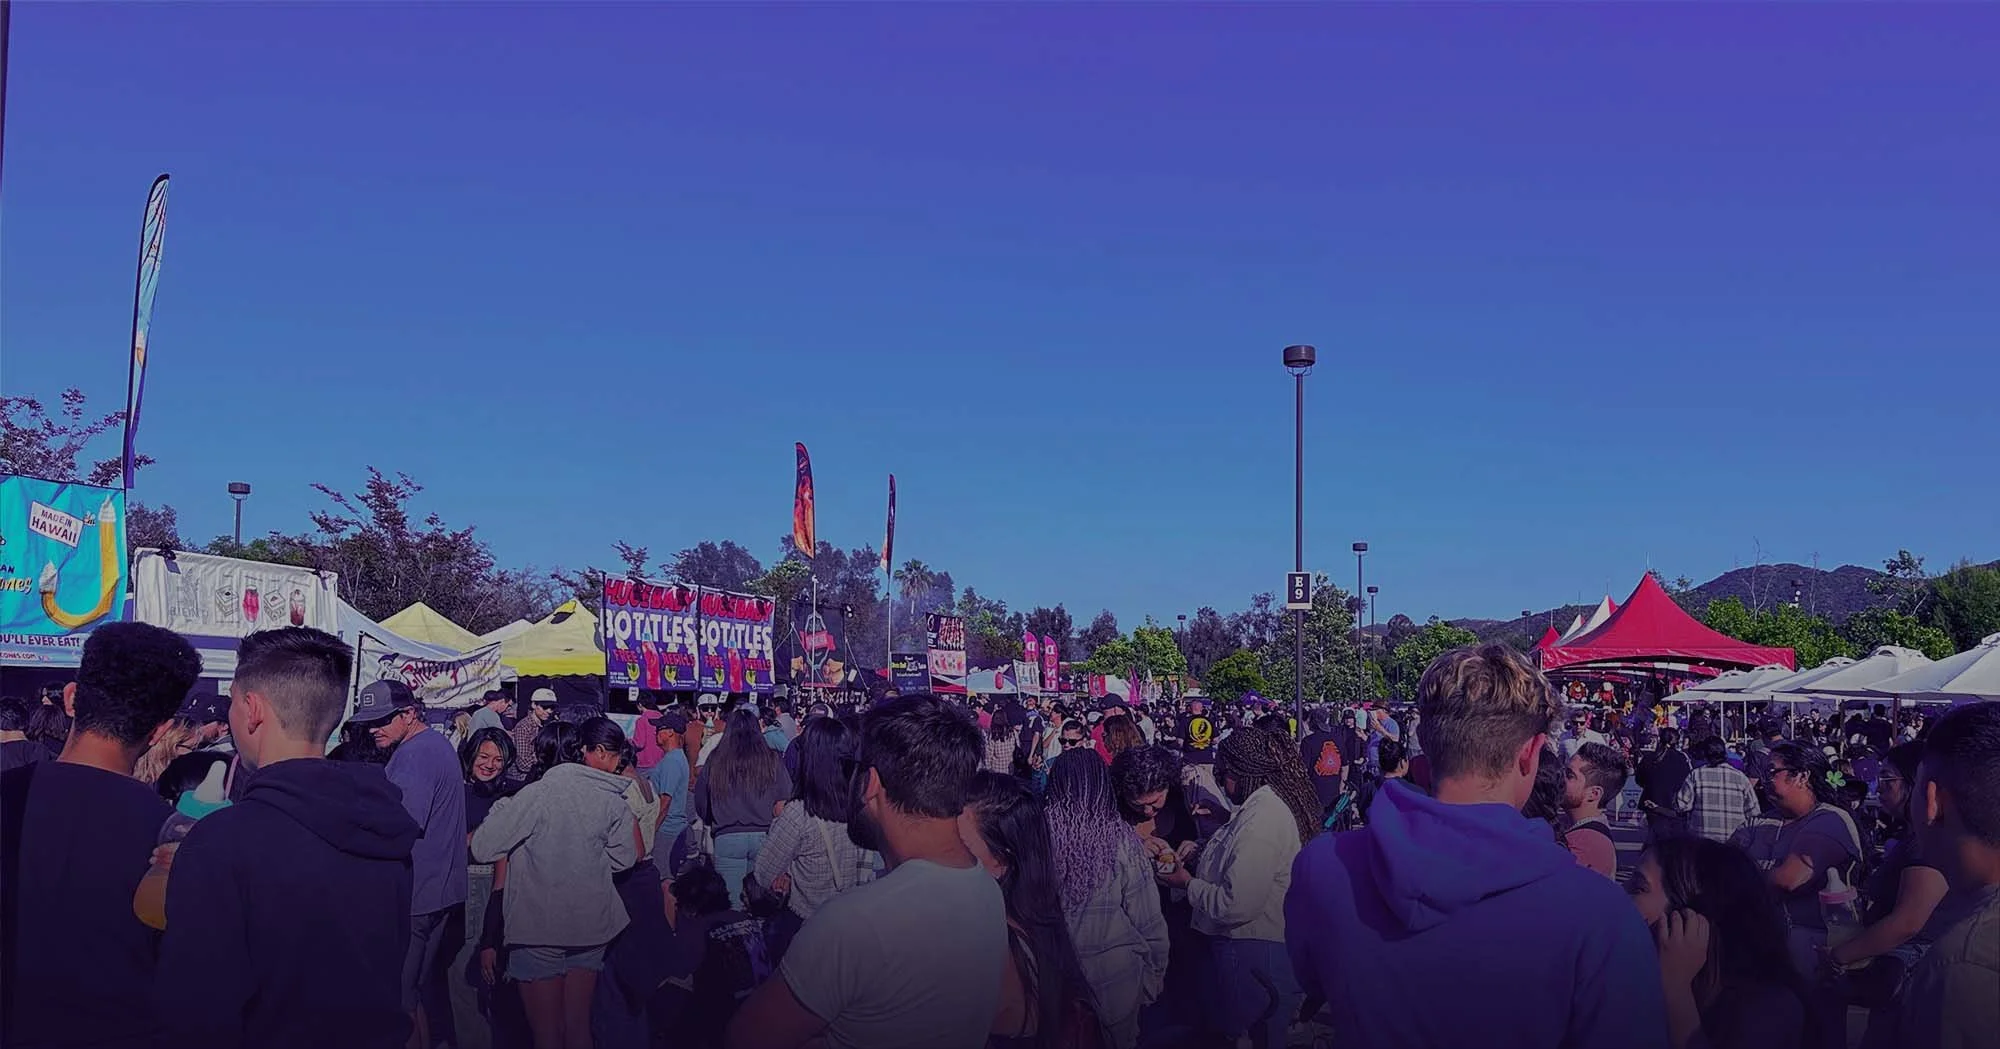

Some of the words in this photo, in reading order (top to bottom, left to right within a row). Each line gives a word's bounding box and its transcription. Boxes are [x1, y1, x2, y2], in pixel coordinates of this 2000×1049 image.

[41, 510, 65, 525] MADE
[31, 516, 77, 543] HAWAII
[1295, 588, 1304, 600] 9
[28, 635, 55, 646] EVER
[58, 637, 80, 647] EAT!
[613, 648, 638, 663] FREE
